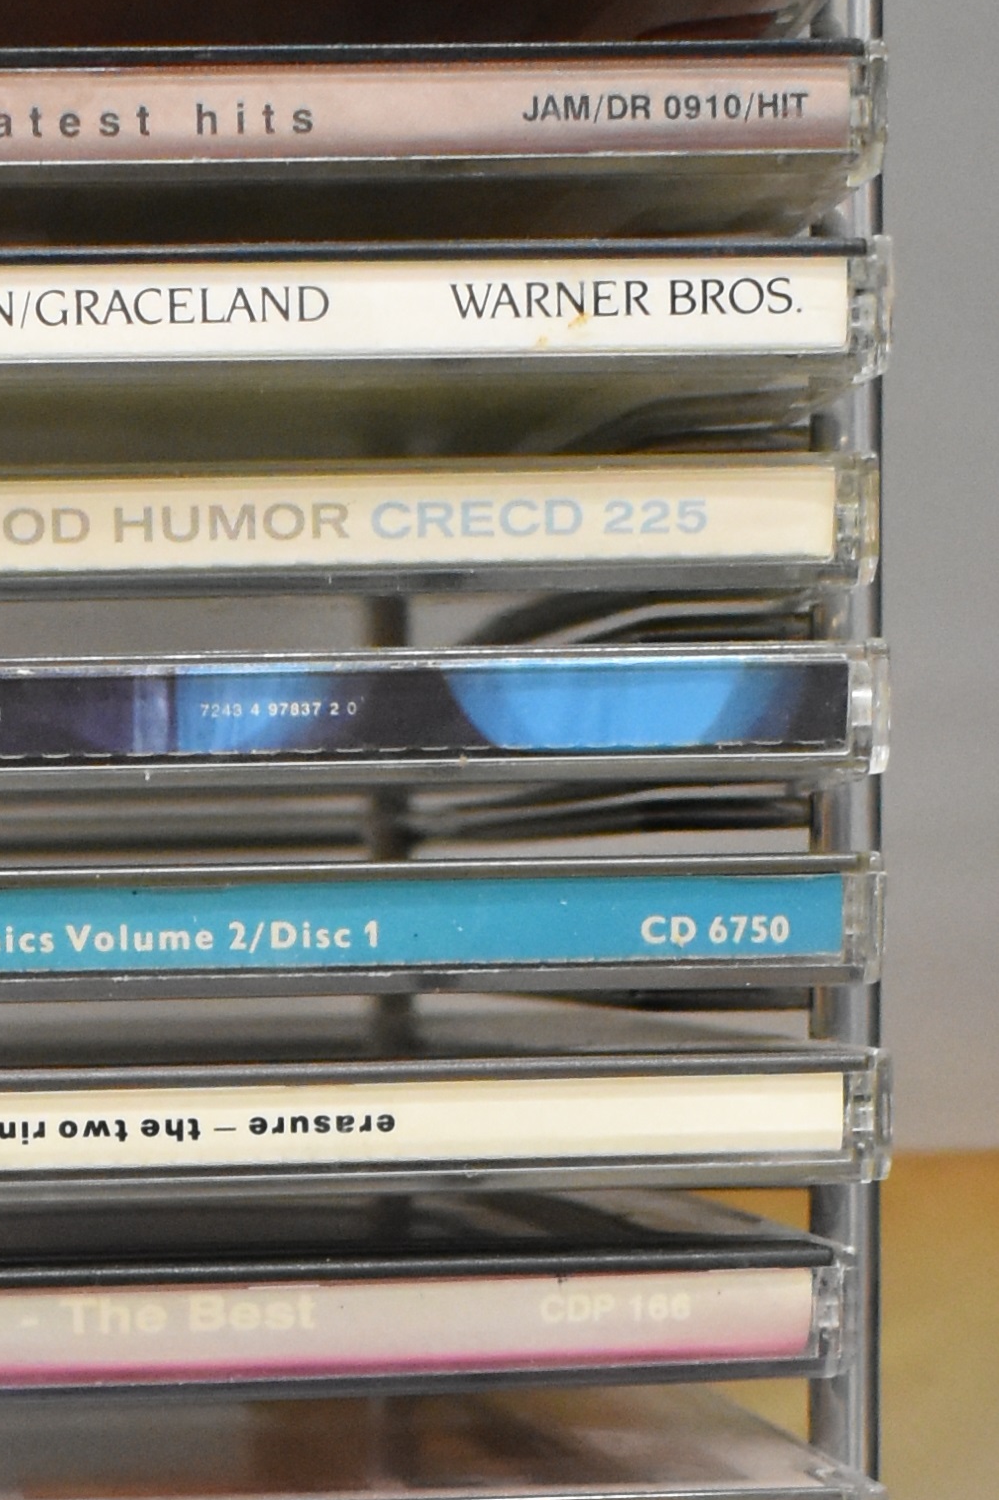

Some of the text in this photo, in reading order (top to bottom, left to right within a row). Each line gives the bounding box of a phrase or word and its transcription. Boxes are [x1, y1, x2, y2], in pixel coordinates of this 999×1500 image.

[196, 102, 315, 135] hits
[521, 92, 654, 124] JAM/DR
[450, 277, 803, 317] WARNER BROS.
[113, 502, 350, 544] HUMOR
[370, 498, 584, 539] CRECD
[604, 498, 708, 535] 225
[64, 922, 214, 953] Volume
[228, 919, 356, 952] 2/Disc
[640, 914, 791, 947] CD 6750
[59, 1119, 128, 1142] two
[140, 1120, 202, 1142] the
[249, 1113, 397, 1136] erasure
[64, 1293, 168, 1335] The
[189, 1291, 316, 1331] Best
